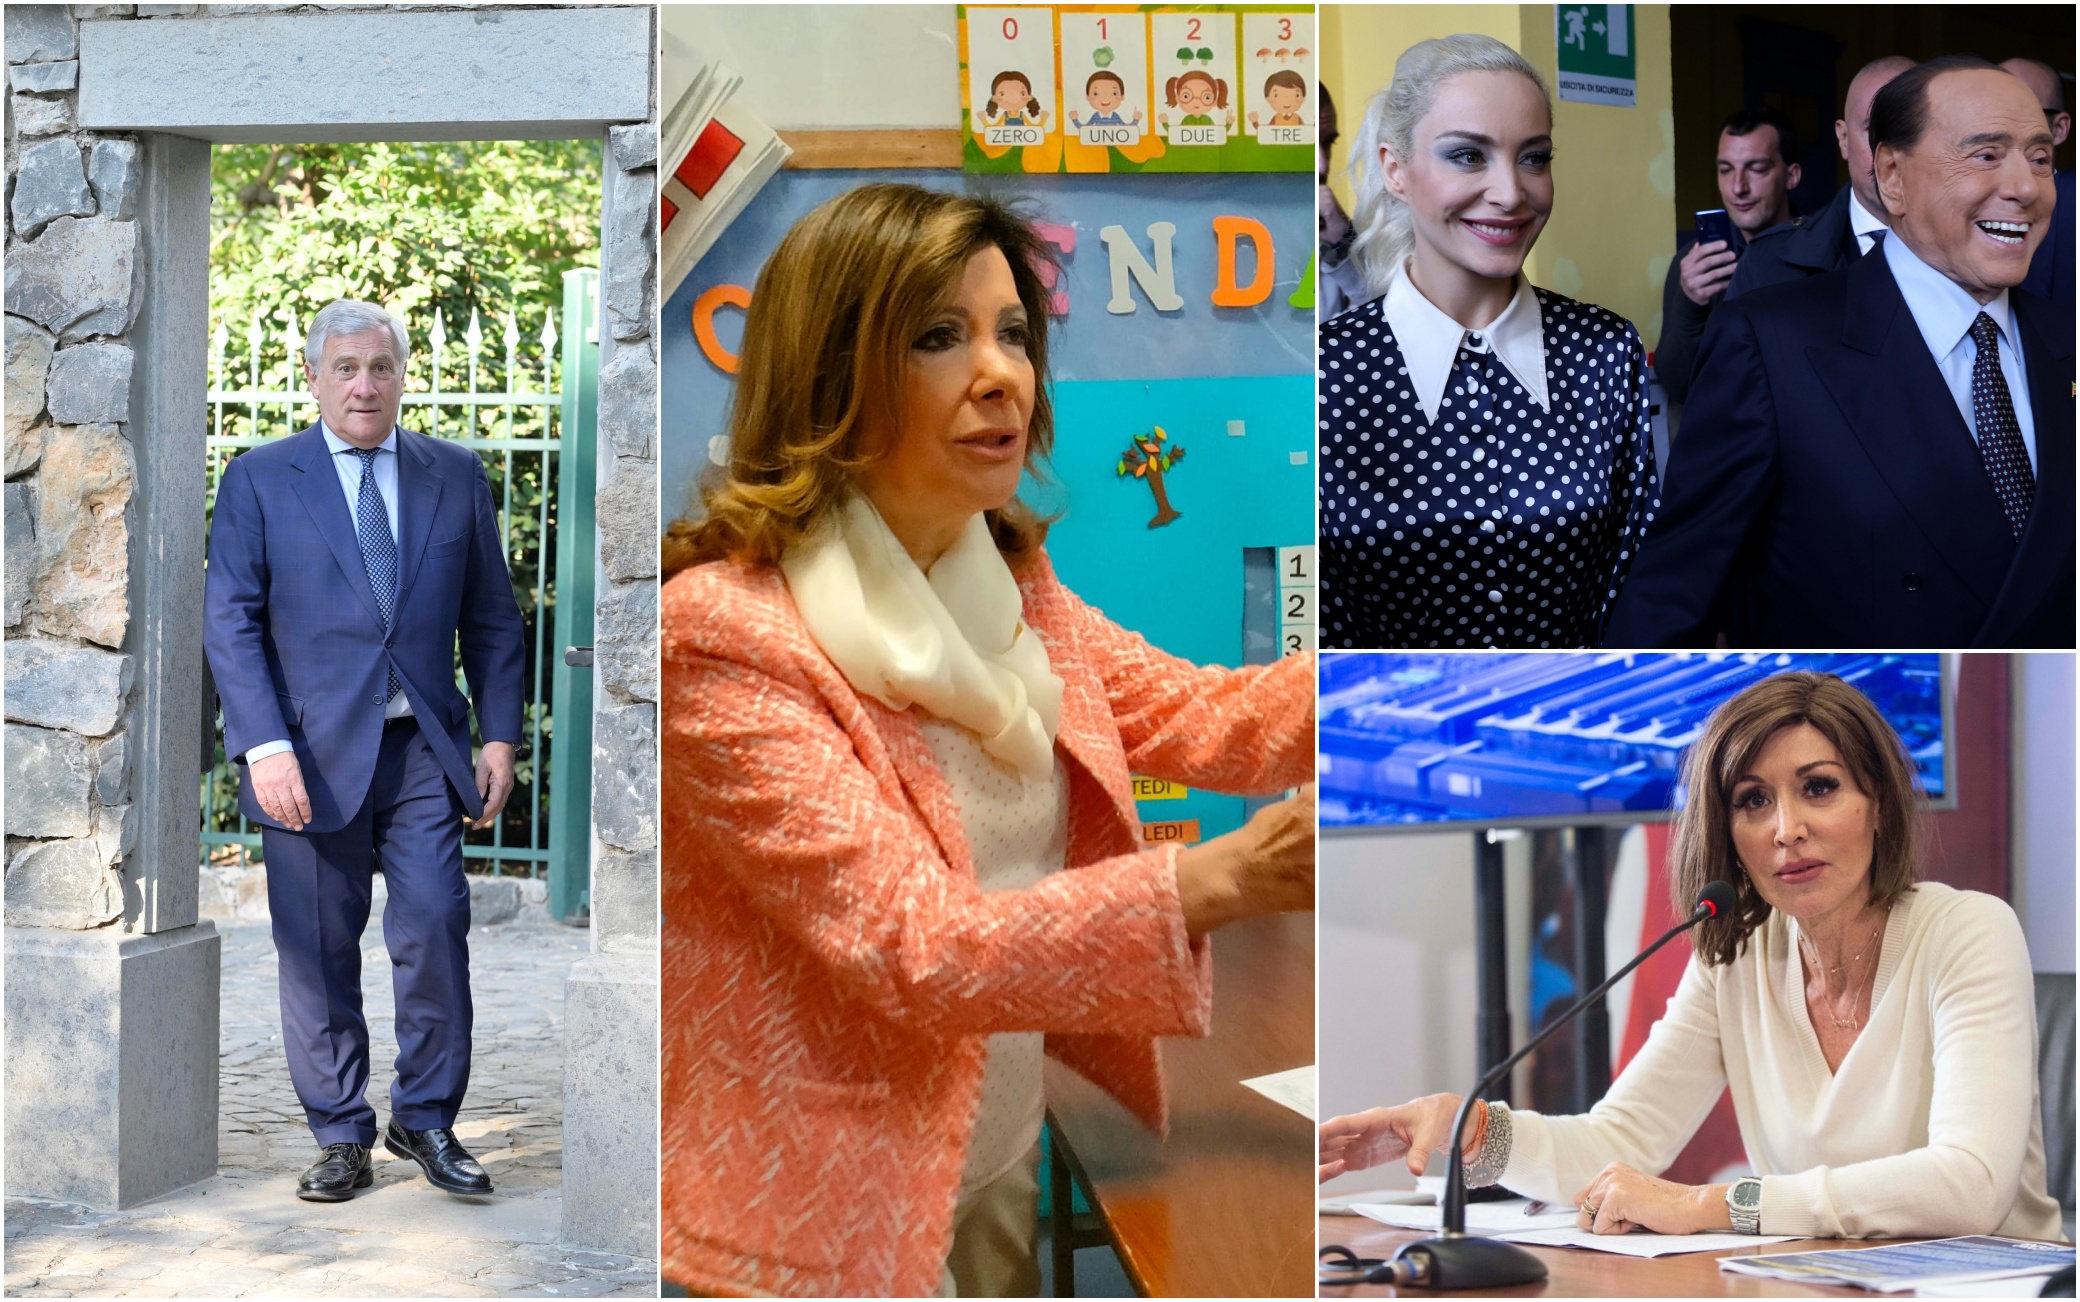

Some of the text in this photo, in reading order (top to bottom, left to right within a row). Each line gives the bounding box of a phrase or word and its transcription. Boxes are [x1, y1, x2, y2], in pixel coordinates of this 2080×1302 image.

[1002, 17, 1019, 41] 0
[1096, 18, 1108, 41] 1
[1186, 18, 1202, 41] 2
[1277, 18, 1292, 41] 3
[1560, 80, 1634, 96] USCITA DI SICUREZZA
[991, 128, 1038, 144] ZERO
[1089, 128, 1130, 144] UNO
[1180, 128, 1216, 143] DUE
[1271, 128, 1302, 143] TRE
[1289, 553, 1307, 578] 1
[1287, 594, 1306, 618] 2
